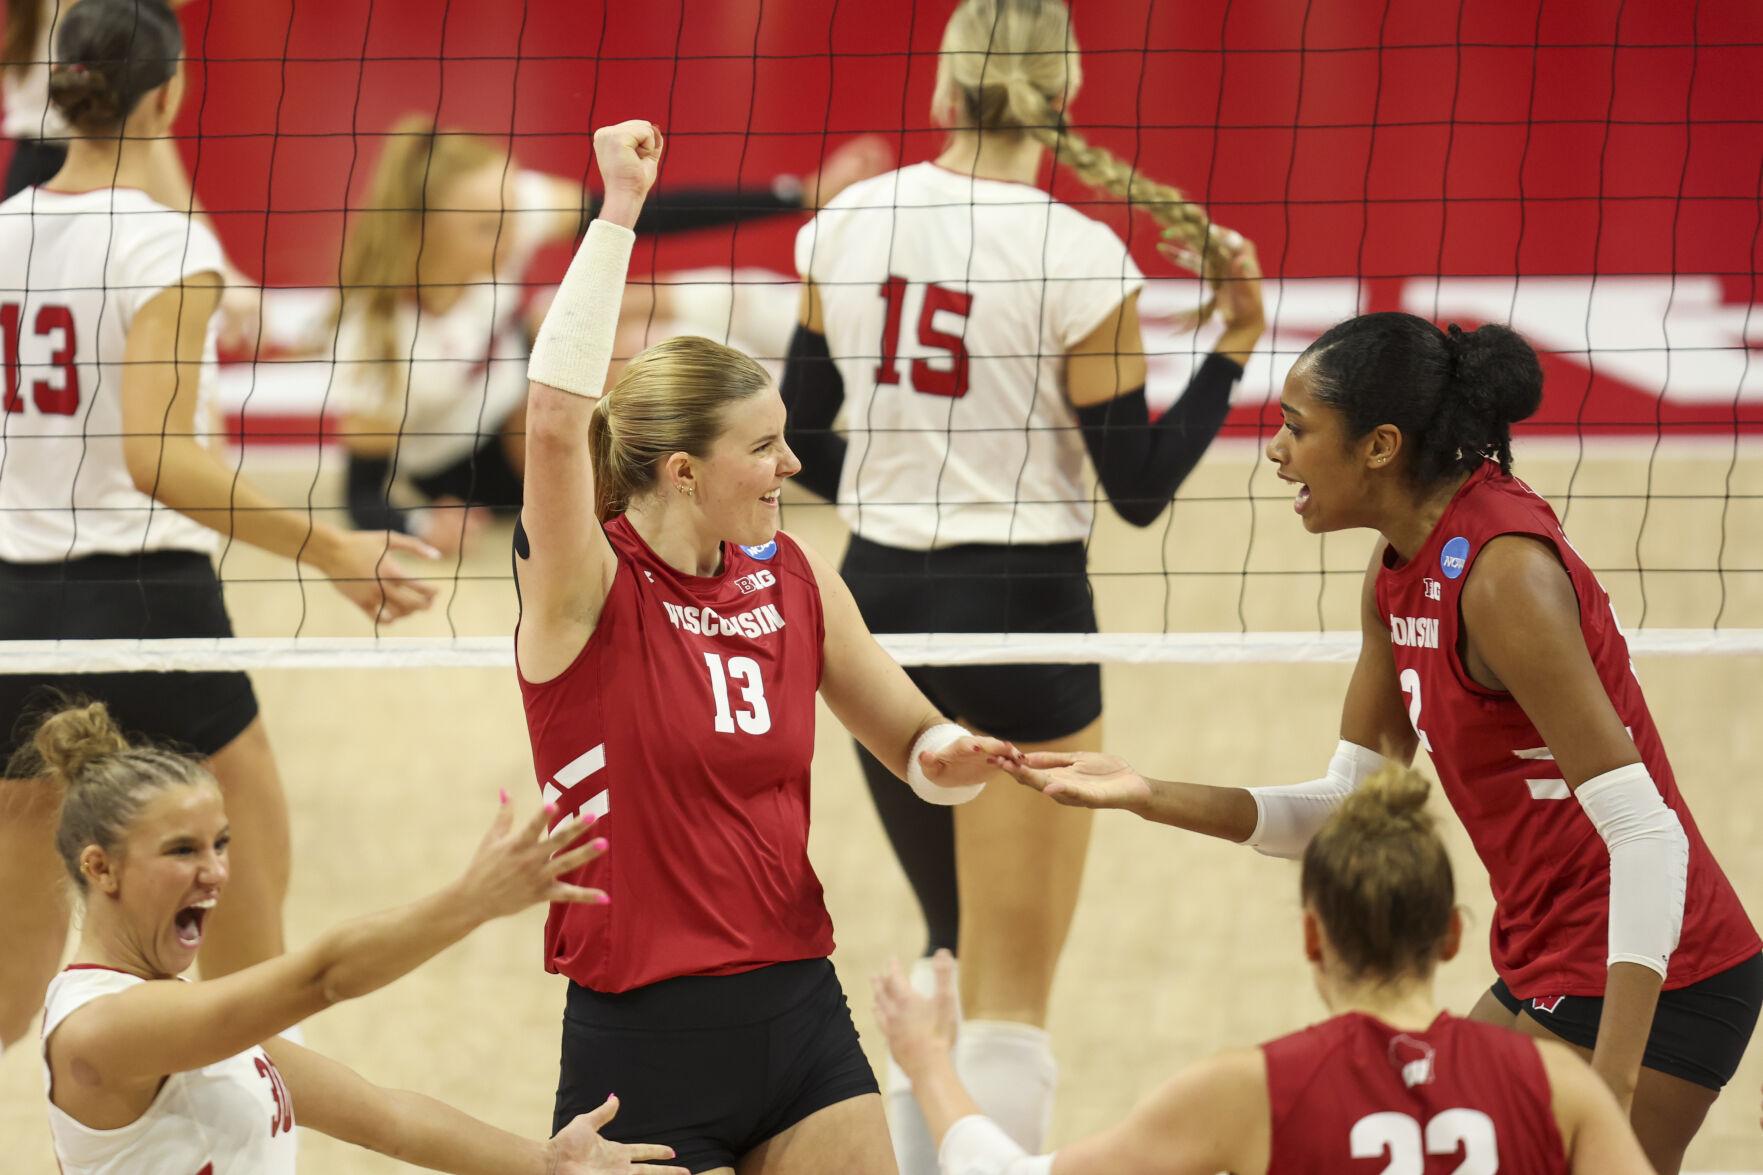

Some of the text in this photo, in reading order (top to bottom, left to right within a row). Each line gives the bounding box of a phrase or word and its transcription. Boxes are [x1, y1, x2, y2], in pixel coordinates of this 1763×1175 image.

[0, 303, 80, 416] 13
[874, 273, 974, 399] 15
[733, 569, 776, 594] BIG
[1390, 613, 1440, 649] ONSIN
[704, 652, 771, 735] 13
[1400, 668, 1433, 752] 2
